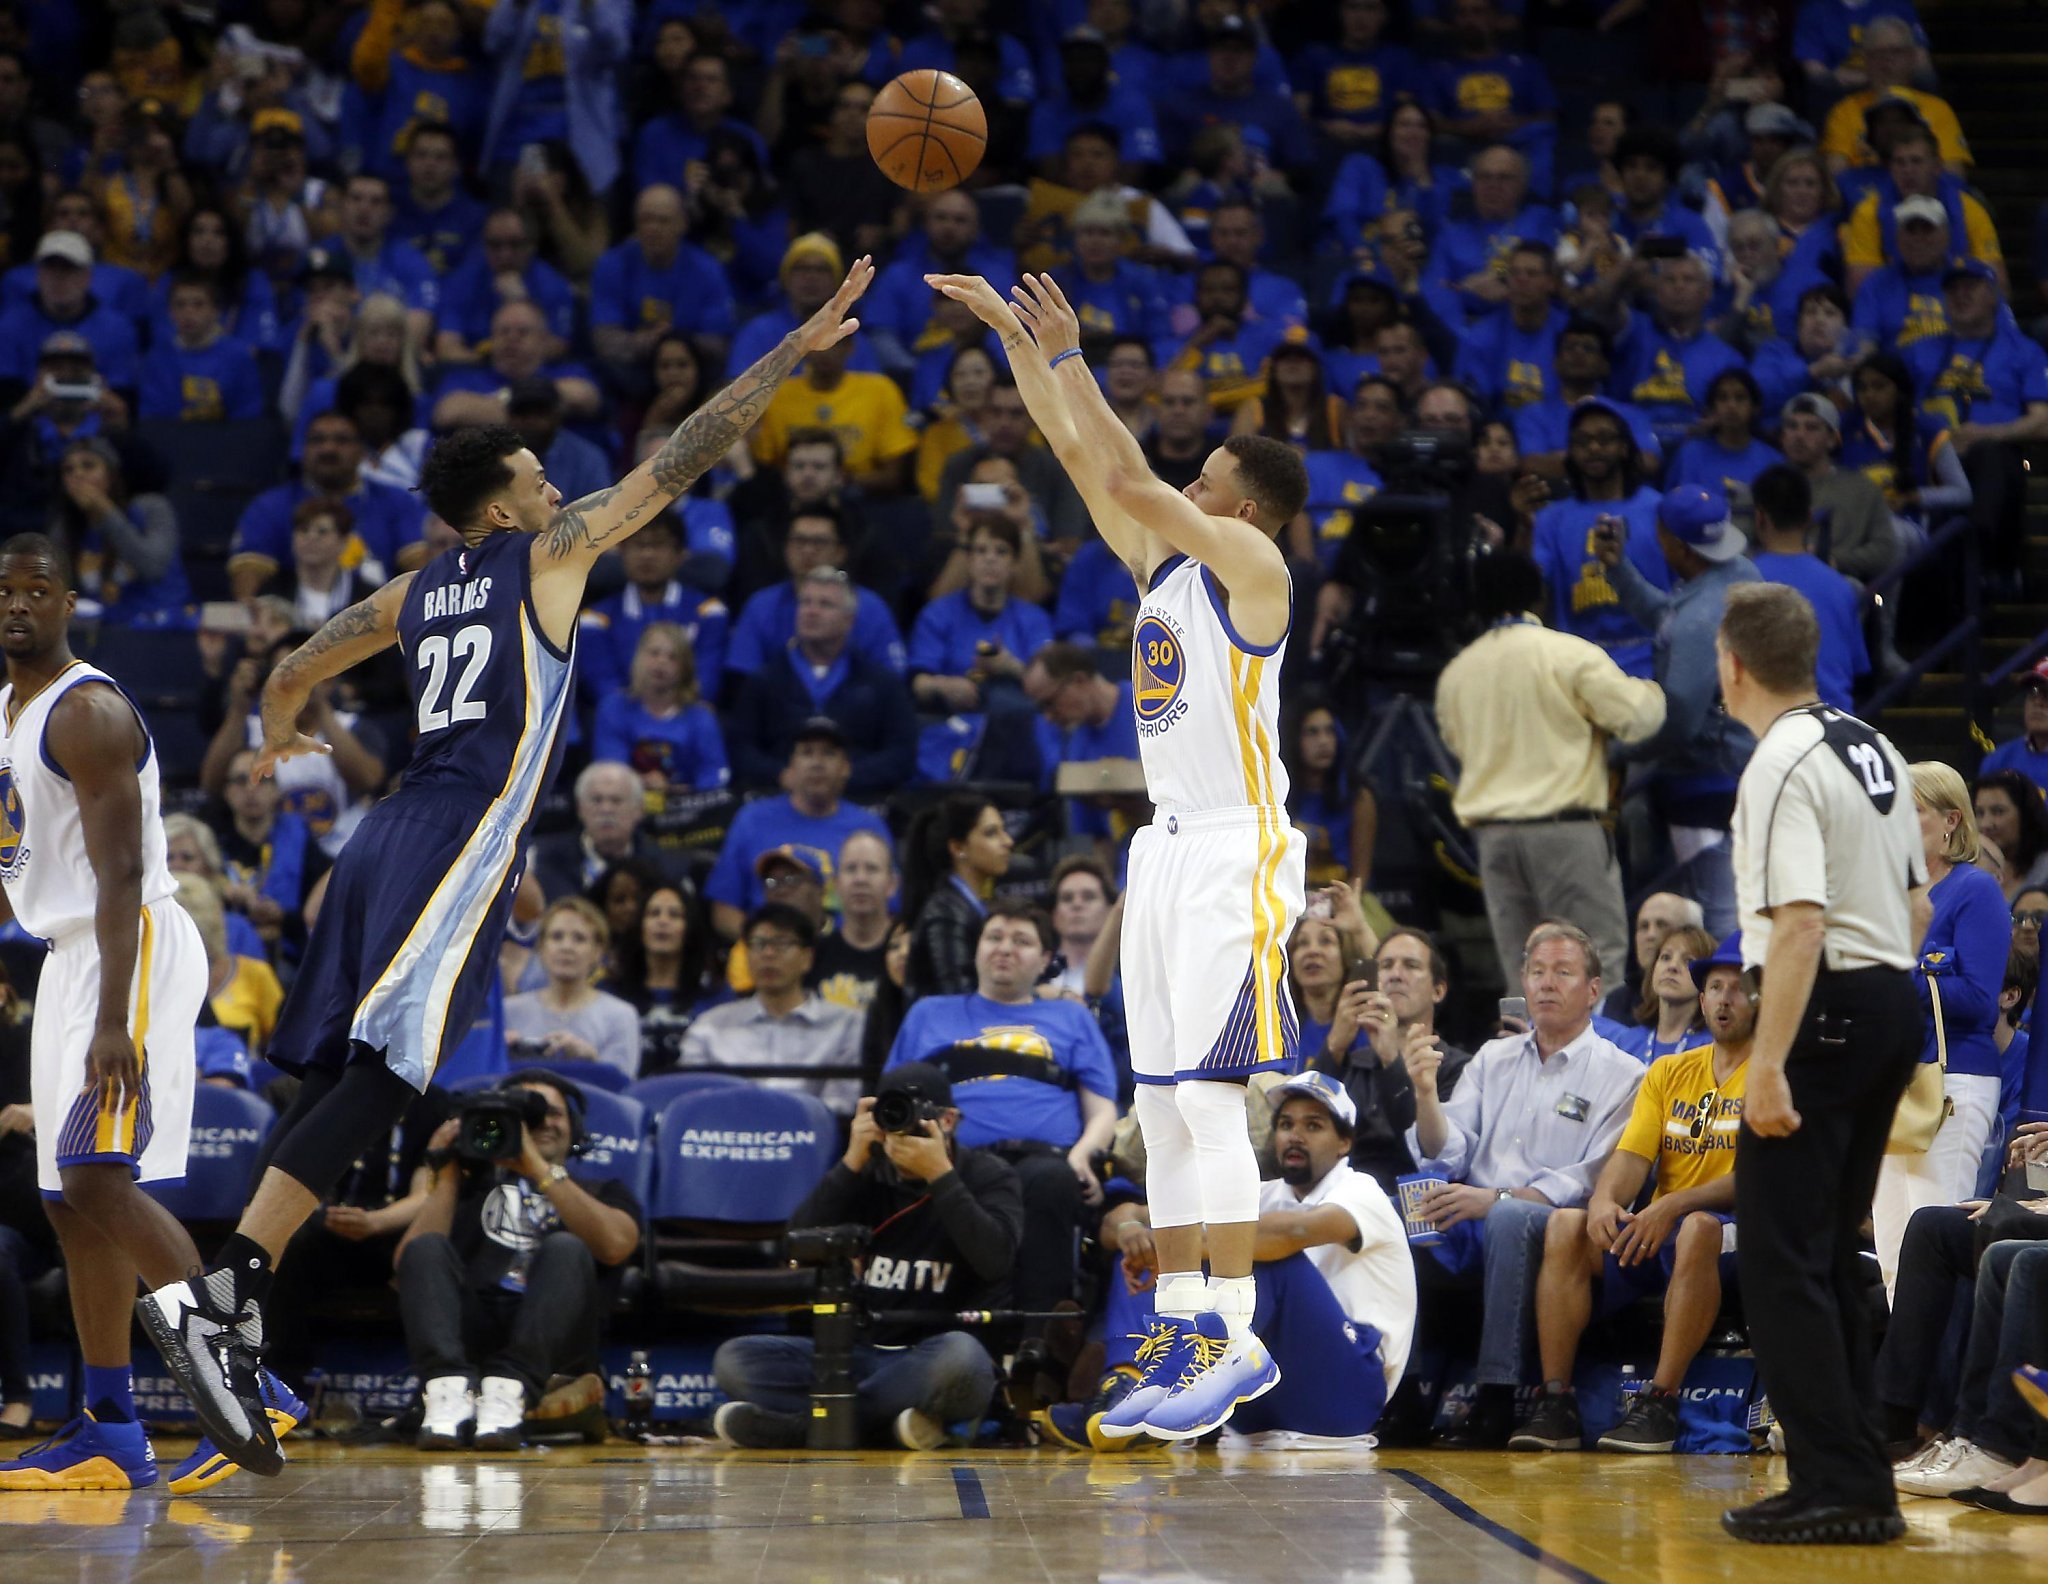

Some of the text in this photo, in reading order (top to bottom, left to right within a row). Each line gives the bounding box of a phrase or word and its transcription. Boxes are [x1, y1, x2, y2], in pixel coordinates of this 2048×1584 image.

[424, 576, 492, 621] BARNES
[1155, 607, 1185, 638] STATE
[1147, 640, 1174, 667] 30
[417, 624, 493, 734] 22
[681, 1128, 816, 1146] AMERICAN
[680, 1143, 792, 1161] EXPRESS
